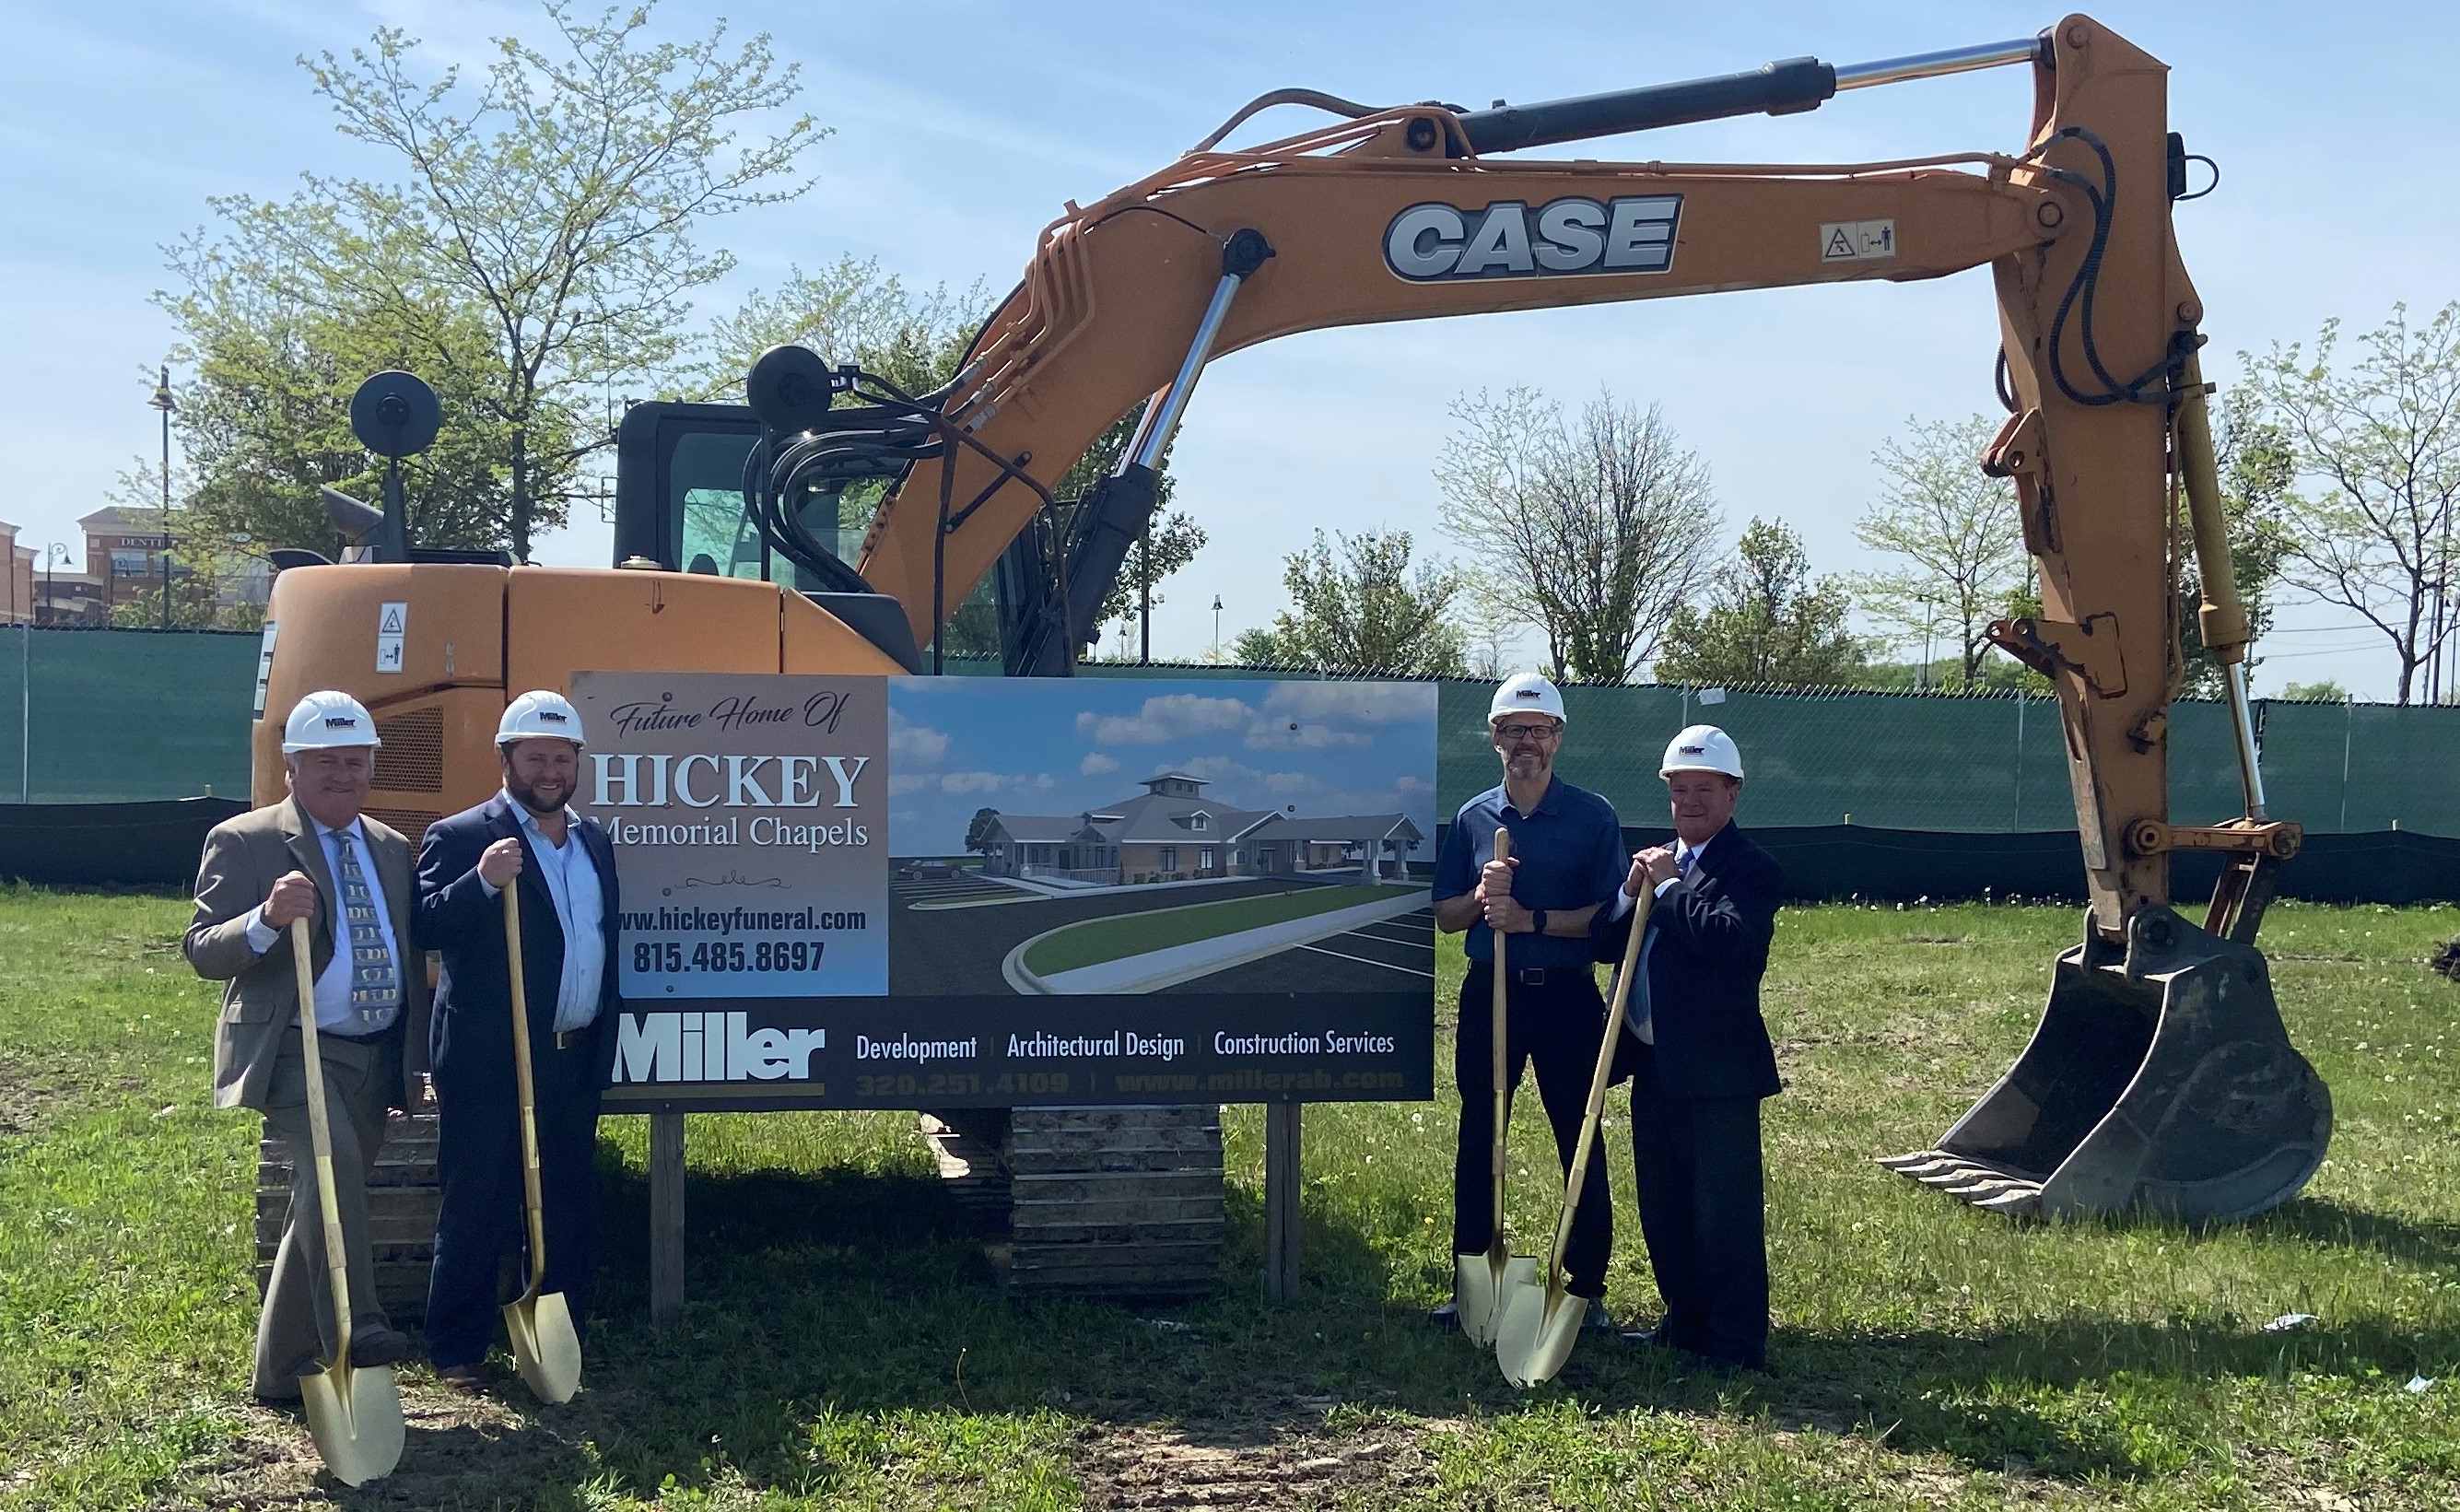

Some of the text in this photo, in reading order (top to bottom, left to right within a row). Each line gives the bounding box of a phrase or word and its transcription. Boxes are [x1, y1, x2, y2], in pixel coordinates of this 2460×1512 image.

[1388, 201, 1677, 276] CASE
[325, 718, 356, 729] Miller
[609, 691, 851, 738] Future Home Of
[1679, 745, 1705, 756] Miller
[589, 754, 870, 808] HICKEY
[590, 815, 869, 854] Memorial Chapels
[618, 906, 866, 936] ww.hickeyfuneral.com
[633, 942, 826, 973] 815.485.8697
[612, 1011, 826, 1083] Miller
[856, 1029, 1396, 1064] Development Architectural Design Construction Services
[855, 1069, 1405, 1096] 320.251.4109 www.millerab.com
